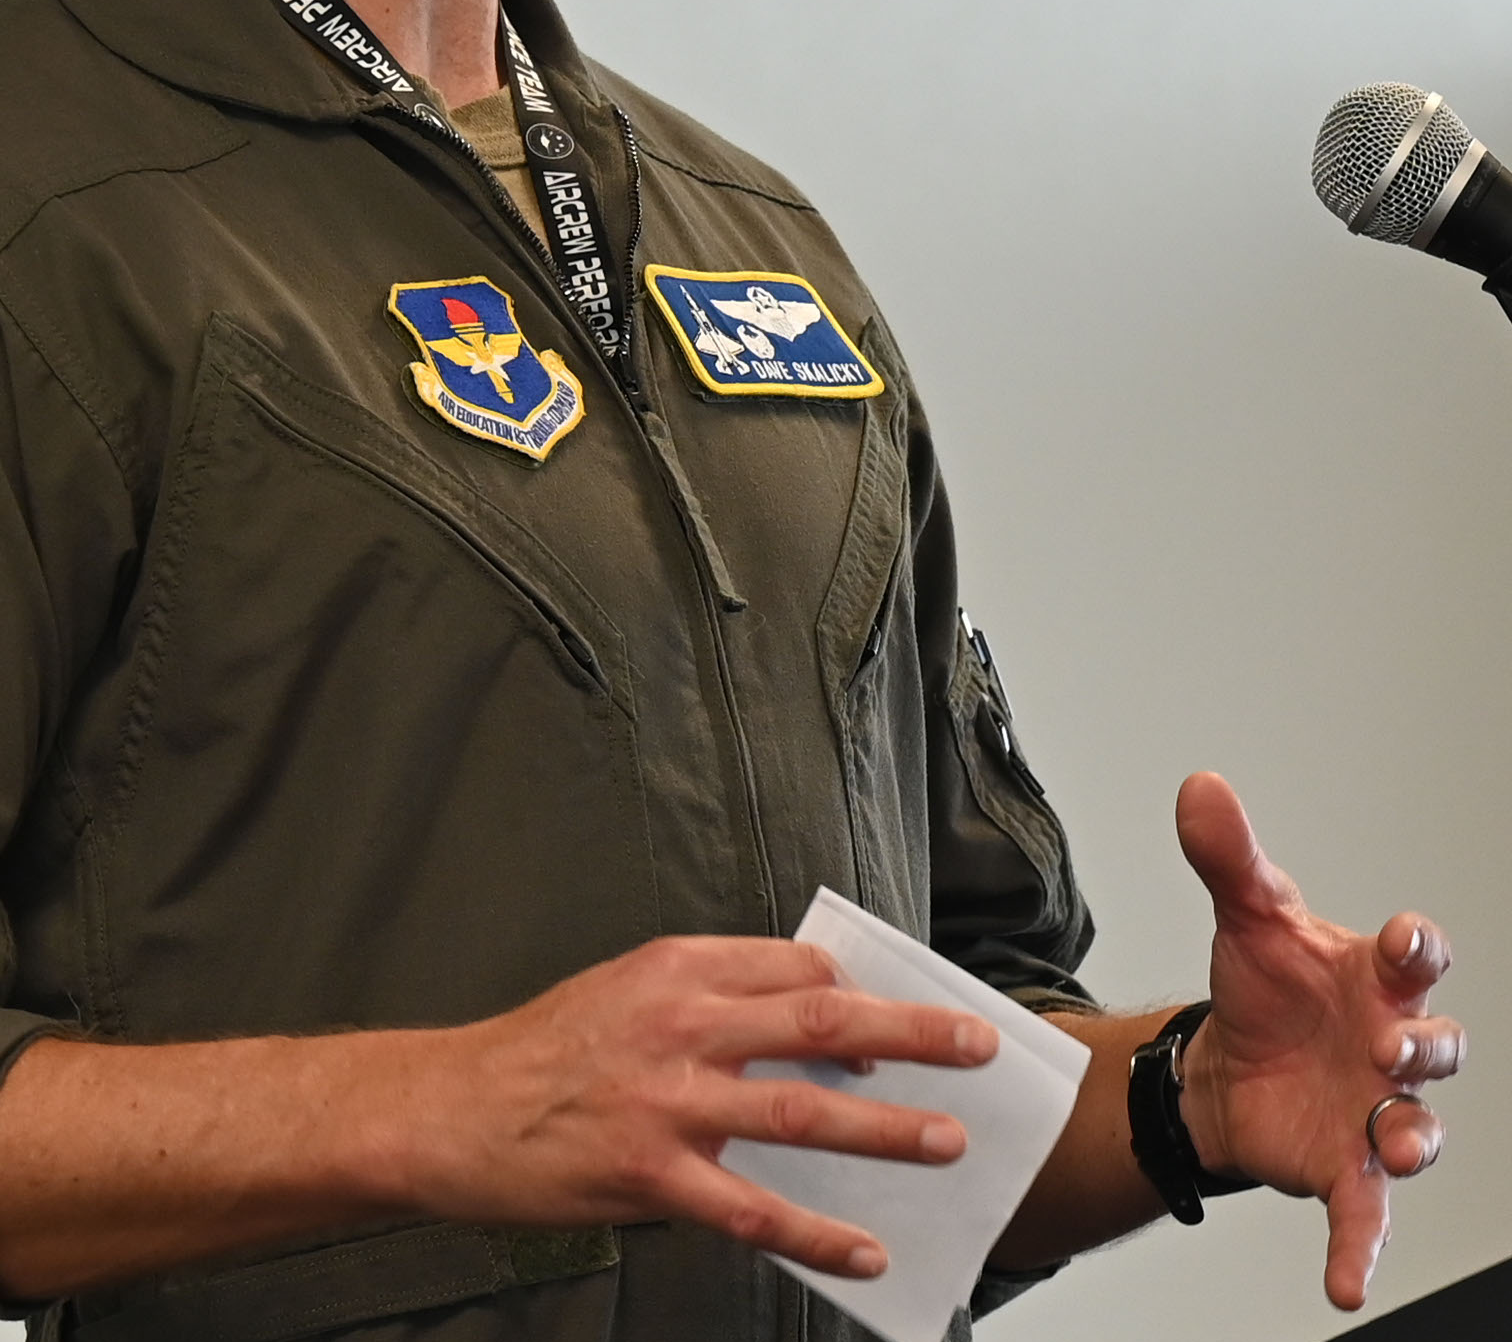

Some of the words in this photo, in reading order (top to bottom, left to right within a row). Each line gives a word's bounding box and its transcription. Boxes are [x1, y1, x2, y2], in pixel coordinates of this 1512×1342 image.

[316, 13, 415, 93] AIRCREW
[514, 64, 555, 114] TEAM
[542, 170, 598, 255] AIRCREW
[750, 359, 794, 381] DAVE
[792, 361, 866, 384] SKALICKY
[438, 391, 455, 418] AIR
[456, 405, 514, 441] EDUCATION
[514, 428, 526, 445] &
